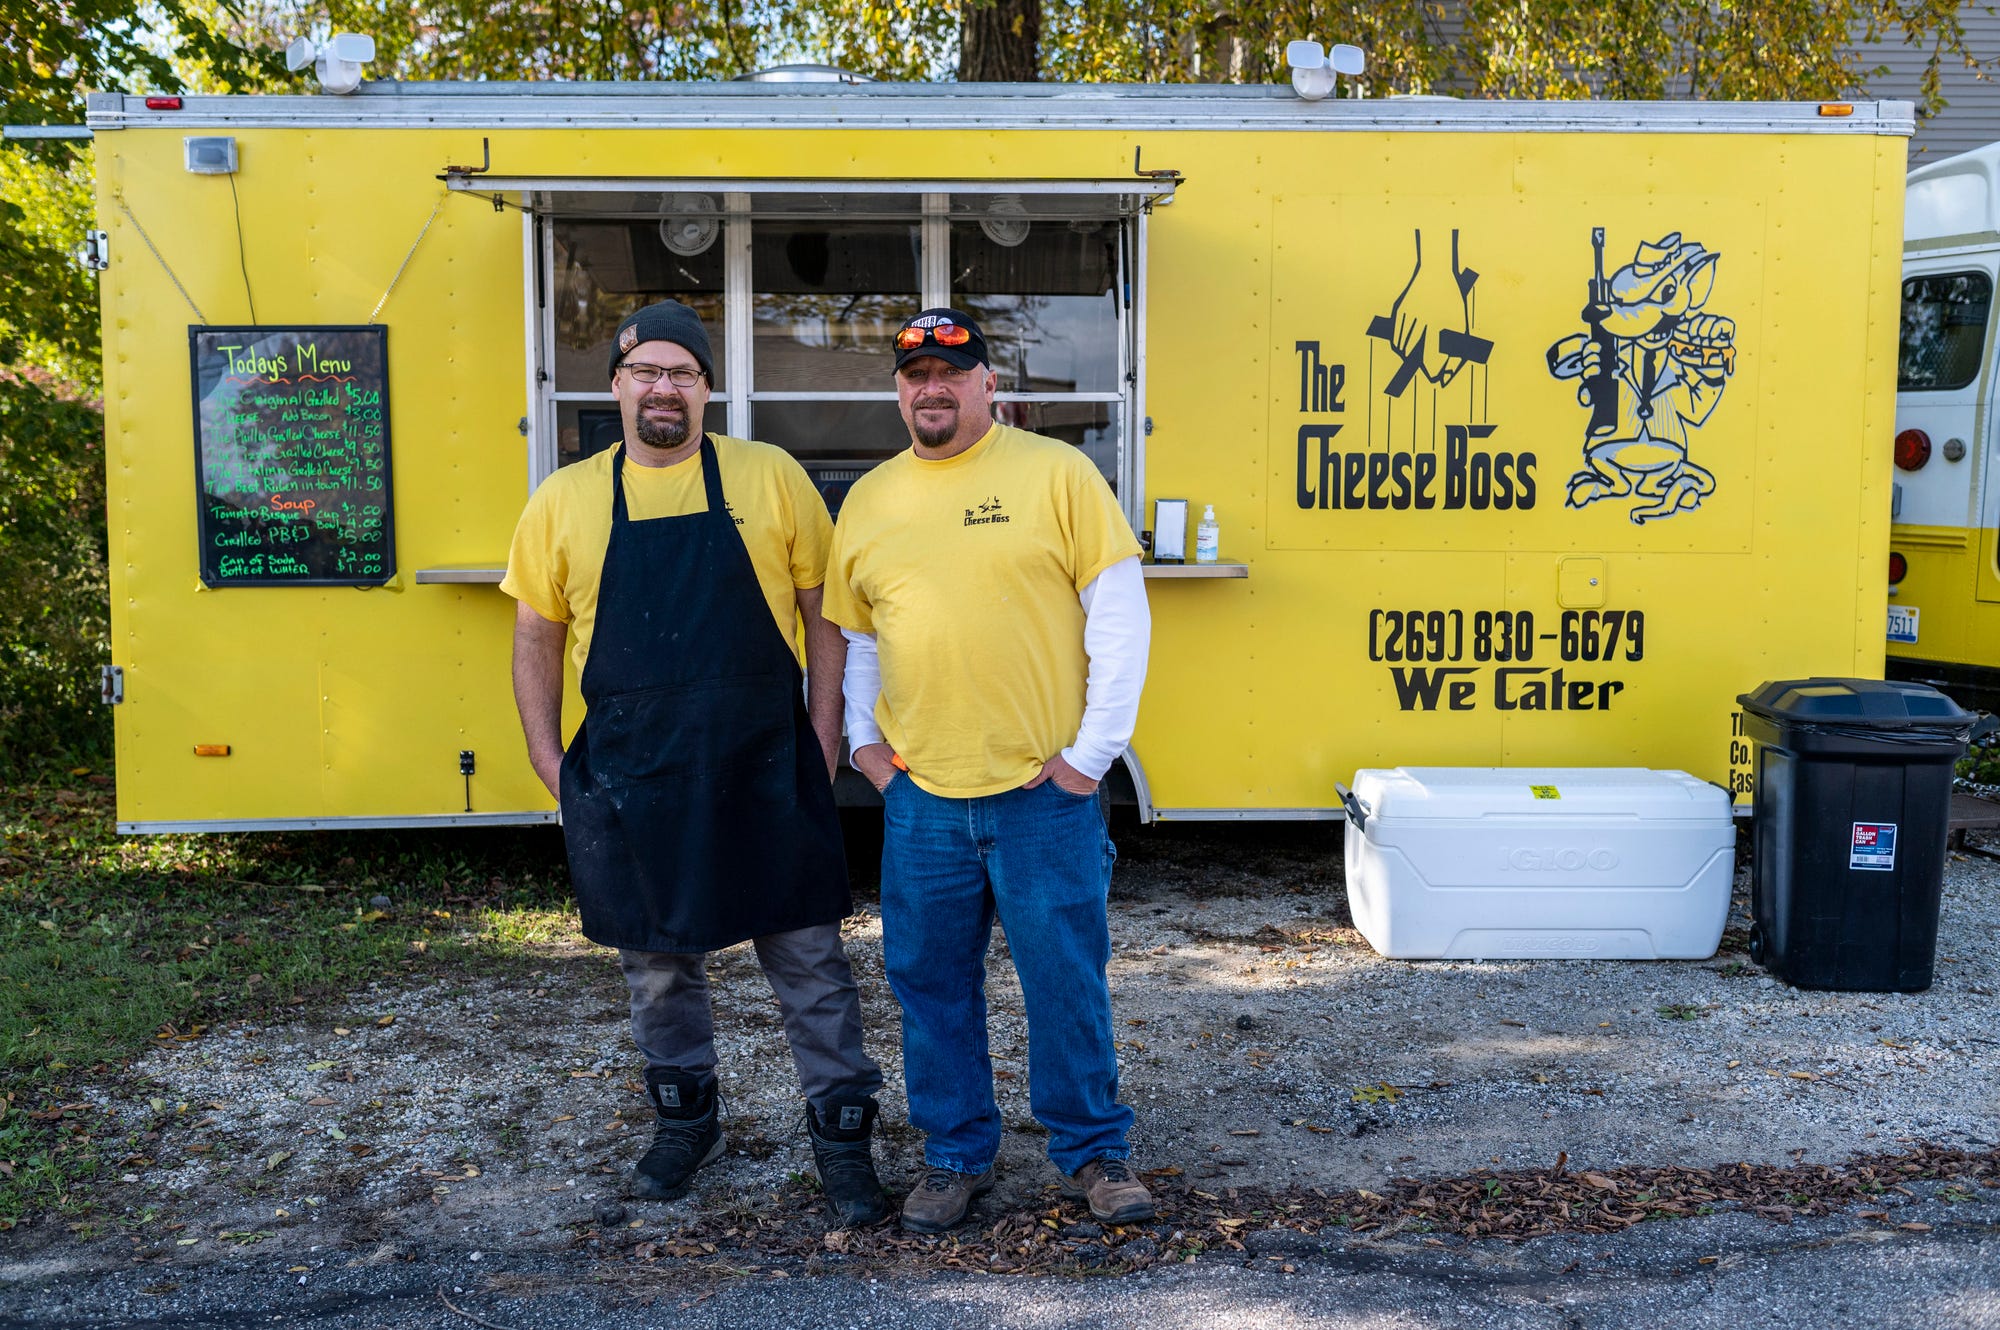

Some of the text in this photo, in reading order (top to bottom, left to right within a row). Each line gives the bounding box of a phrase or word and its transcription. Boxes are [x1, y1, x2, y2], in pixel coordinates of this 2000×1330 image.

[297, 343, 351, 374] Menu
[1295, 341, 1345, 412] The
[345, 382, 380, 406] $5.00
[345, 404, 381, 422] $3.00
[343, 420, 381, 439] $11.50
[1298, 425, 1537, 510] Cheese Boss
[340, 475, 383, 491] $11.50
[271, 494, 316, 515] Soup
[342, 501, 381, 518] $2.00
[964, 514, 1010, 526] Cheese Boss
[268, 525, 310, 544] PB&J
[337, 527, 382, 544] $5.00
[339, 546, 381, 563] $2.00
[337, 559, 381, 574] $1.00
[1369, 609, 1463, 662] (269)
[1888, 616, 1913, 635] 7511
[1389, 667, 1624, 711] We Cater
[1730, 740, 1751, 765] Co.
[1498, 846, 1620, 872] IGLOO
